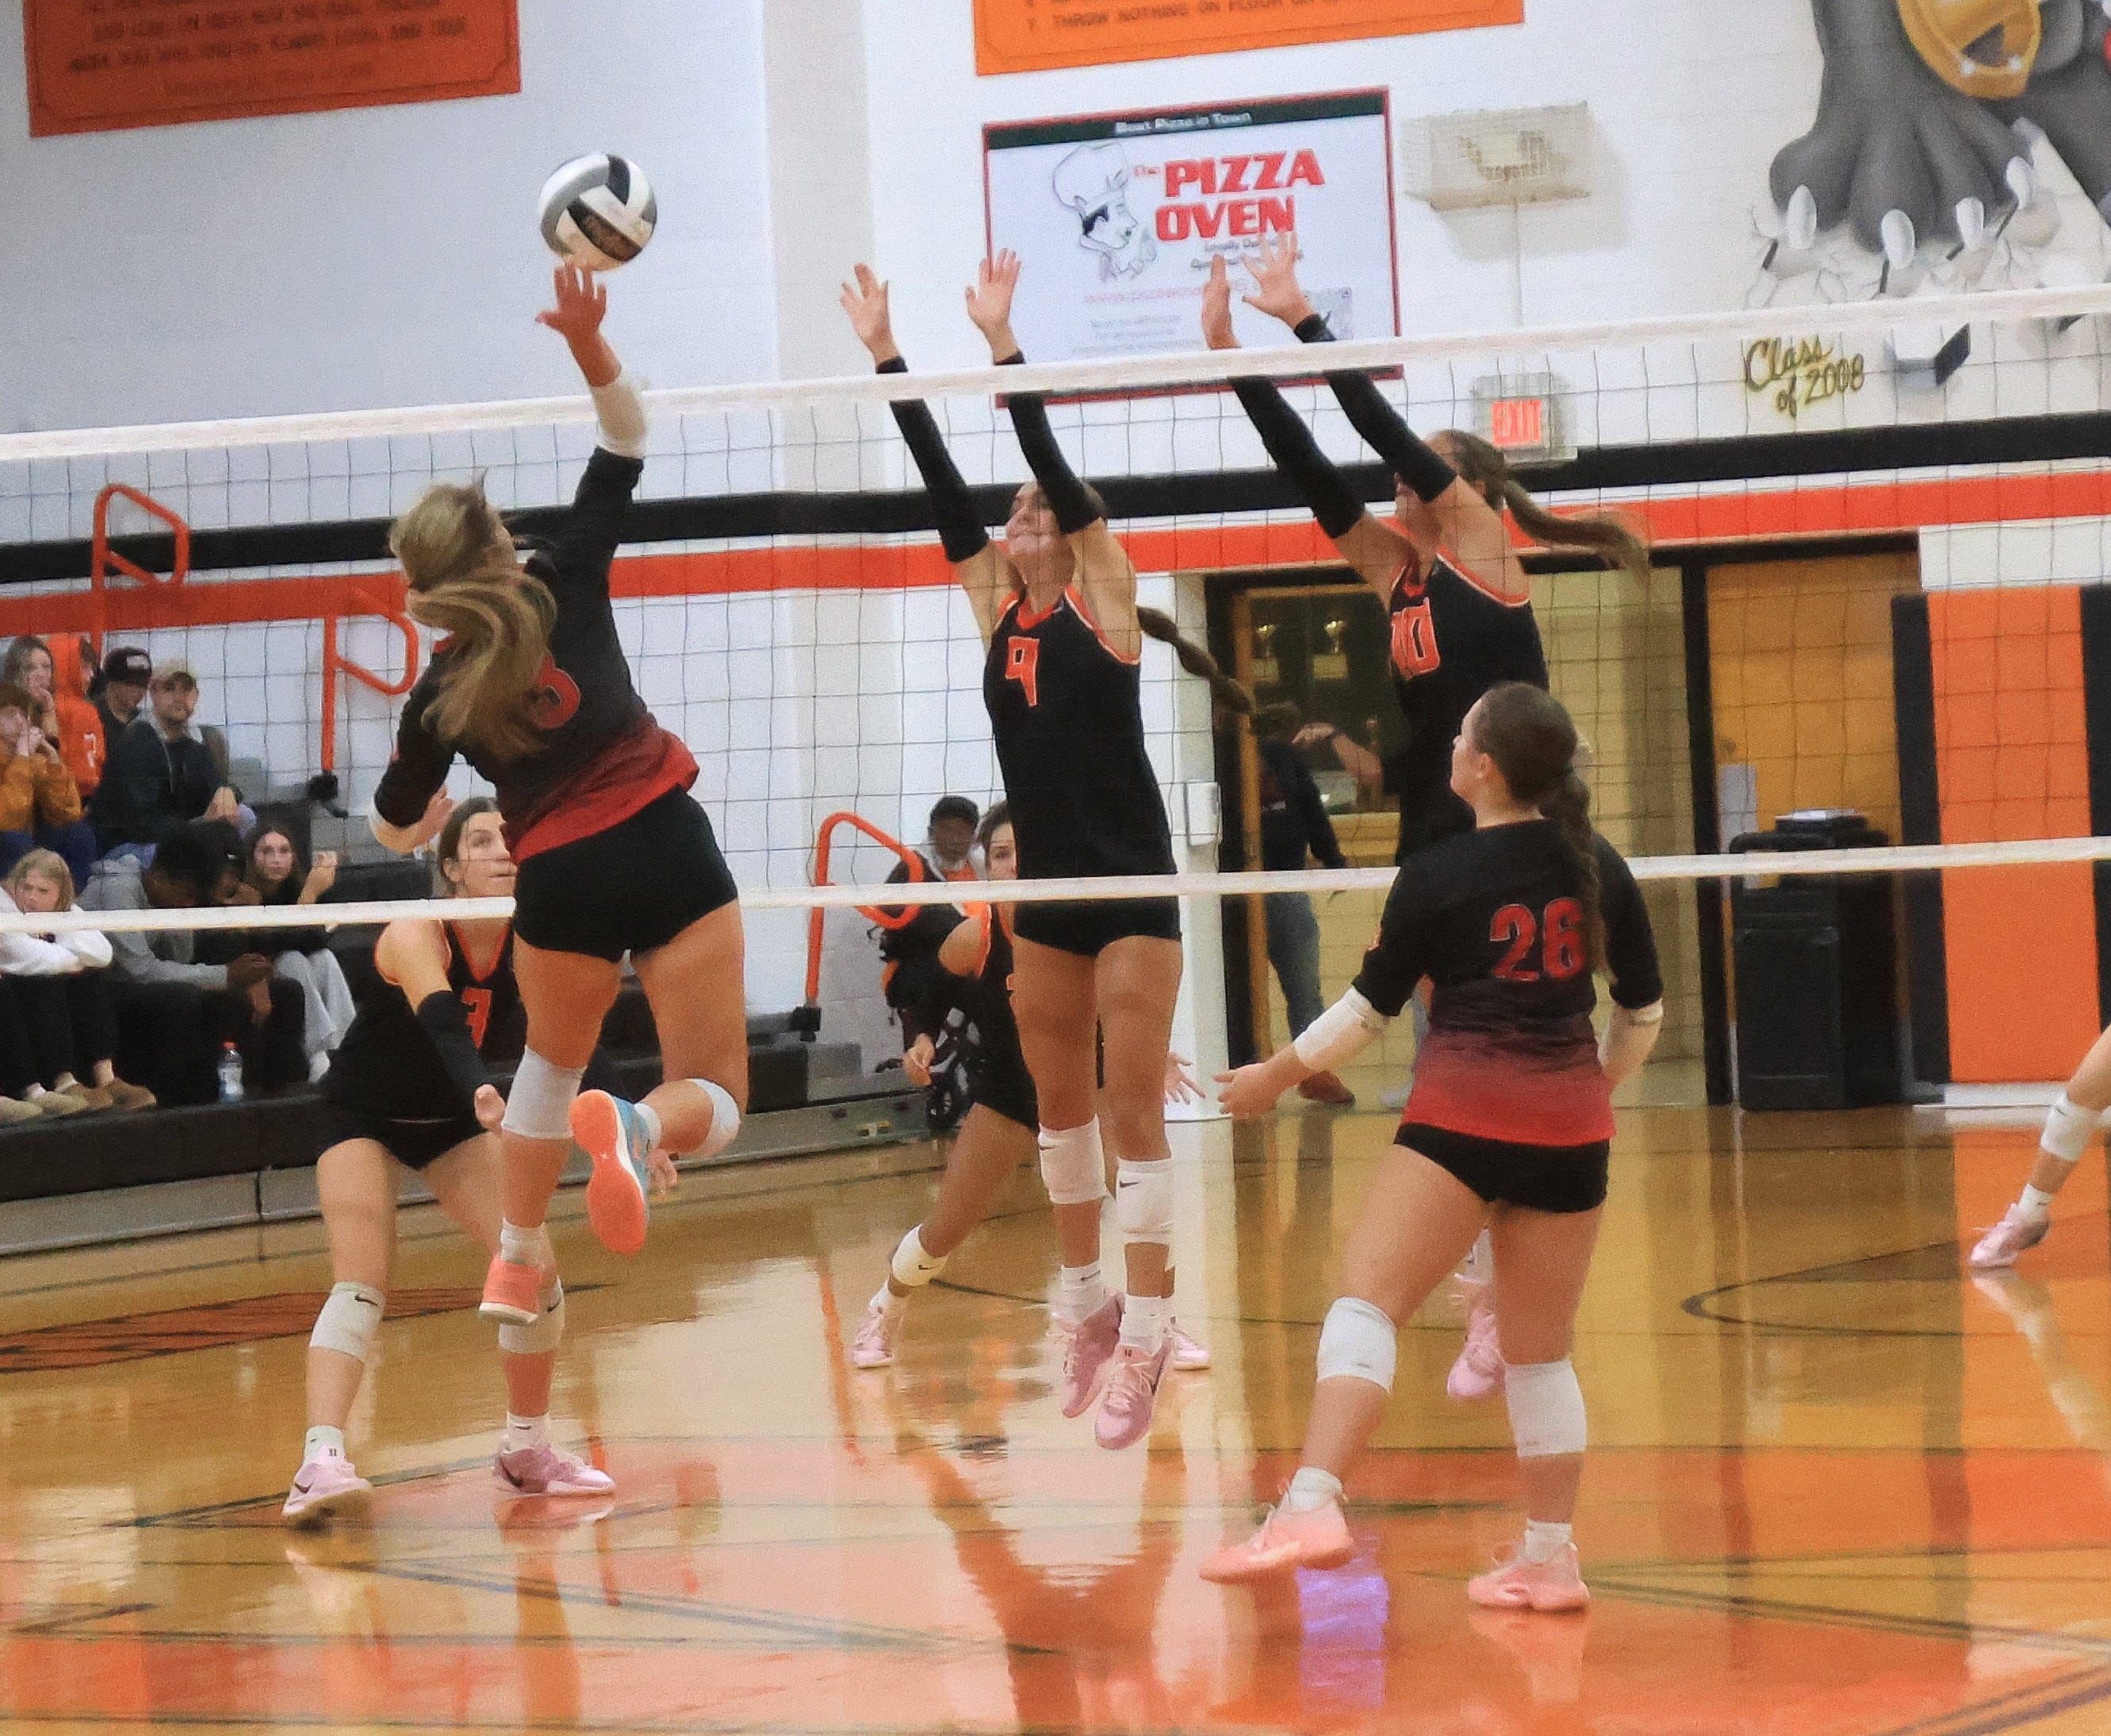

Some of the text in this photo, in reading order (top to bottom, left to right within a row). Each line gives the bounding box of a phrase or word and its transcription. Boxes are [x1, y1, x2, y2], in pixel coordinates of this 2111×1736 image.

[1165, 148, 1325, 198] PIZZA
[1155, 195, 1294, 242] OVEN
[1745, 334, 1834, 392] Class
[1776, 370, 1798, 420] of
[1491, 400, 1542, 446] EXIT
[1005, 636, 1040, 706] 9
[1490, 897, 1586, 982] 26
